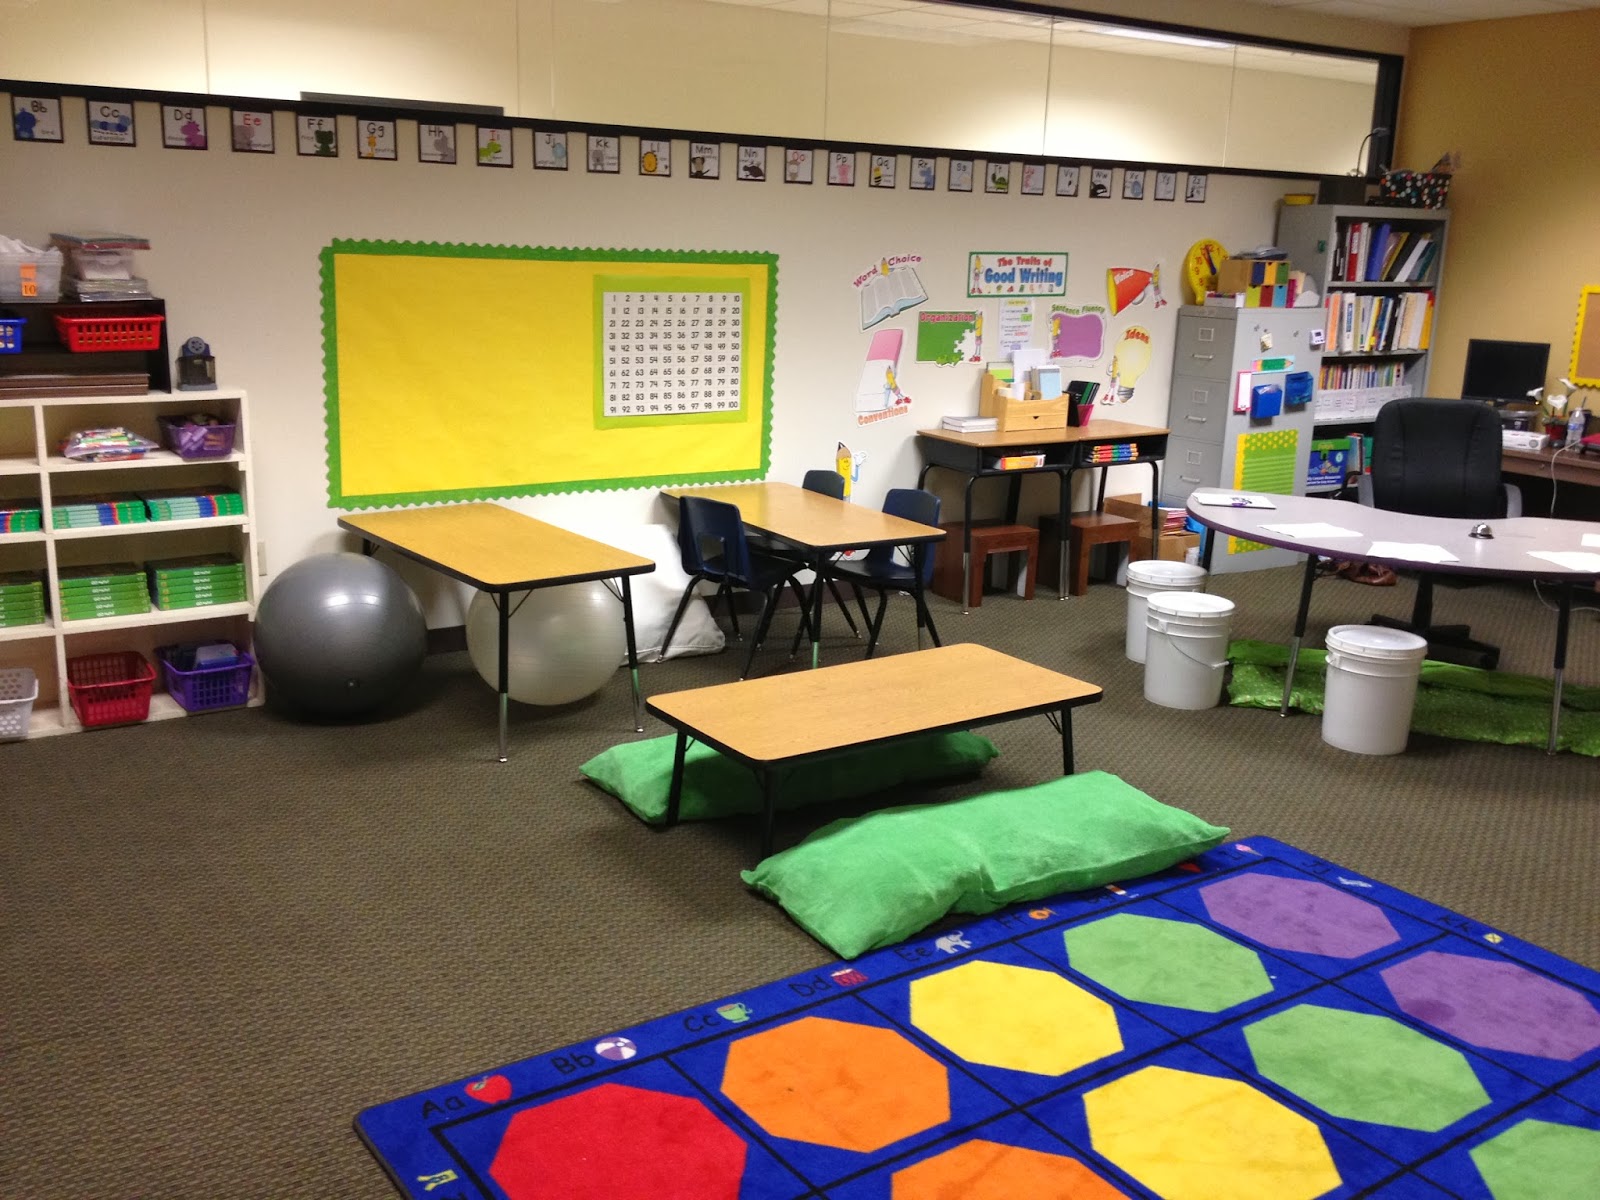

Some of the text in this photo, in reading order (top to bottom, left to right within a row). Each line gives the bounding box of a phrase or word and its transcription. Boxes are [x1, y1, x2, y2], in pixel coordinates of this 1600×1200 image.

[31, 100, 48, 113] Bb
[100, 106, 120, 118] Cc
[174, 109, 193, 121] Dd
[243, 114, 262, 126] Ee
[307, 118, 323, 129] Ff
[366, 123, 385, 138] Gg
[428, 127, 444, 138] Hh
[545, 134, 556, 149] Jj
[596, 139, 610, 148] Kk
[650, 143, 660, 153] Ll
[695, 146, 713, 154] Mm
[744, 149, 758, 158] Nn
[792, 152, 806, 162] Oo
[918, 160, 928, 168] Rr
[997, 256, 1053, 267] The Traits of
[853, 254, 922, 287] Word Choice
[984, 267, 1062, 287] Good Writing
[1052, 304, 1105, 314] Sentence Fluency
[920, 312, 974, 323] Organization
[1124, 329, 1149, 344] Ideas
[858, 405, 908, 425] Conventions
[894, 942, 934, 962] Ee
[789, 976, 832, 997] Dd
[684, 1014, 721, 1033] Cc
[551, 1052, 596, 1076] Bb
[421, 1095, 467, 1119] Aa
